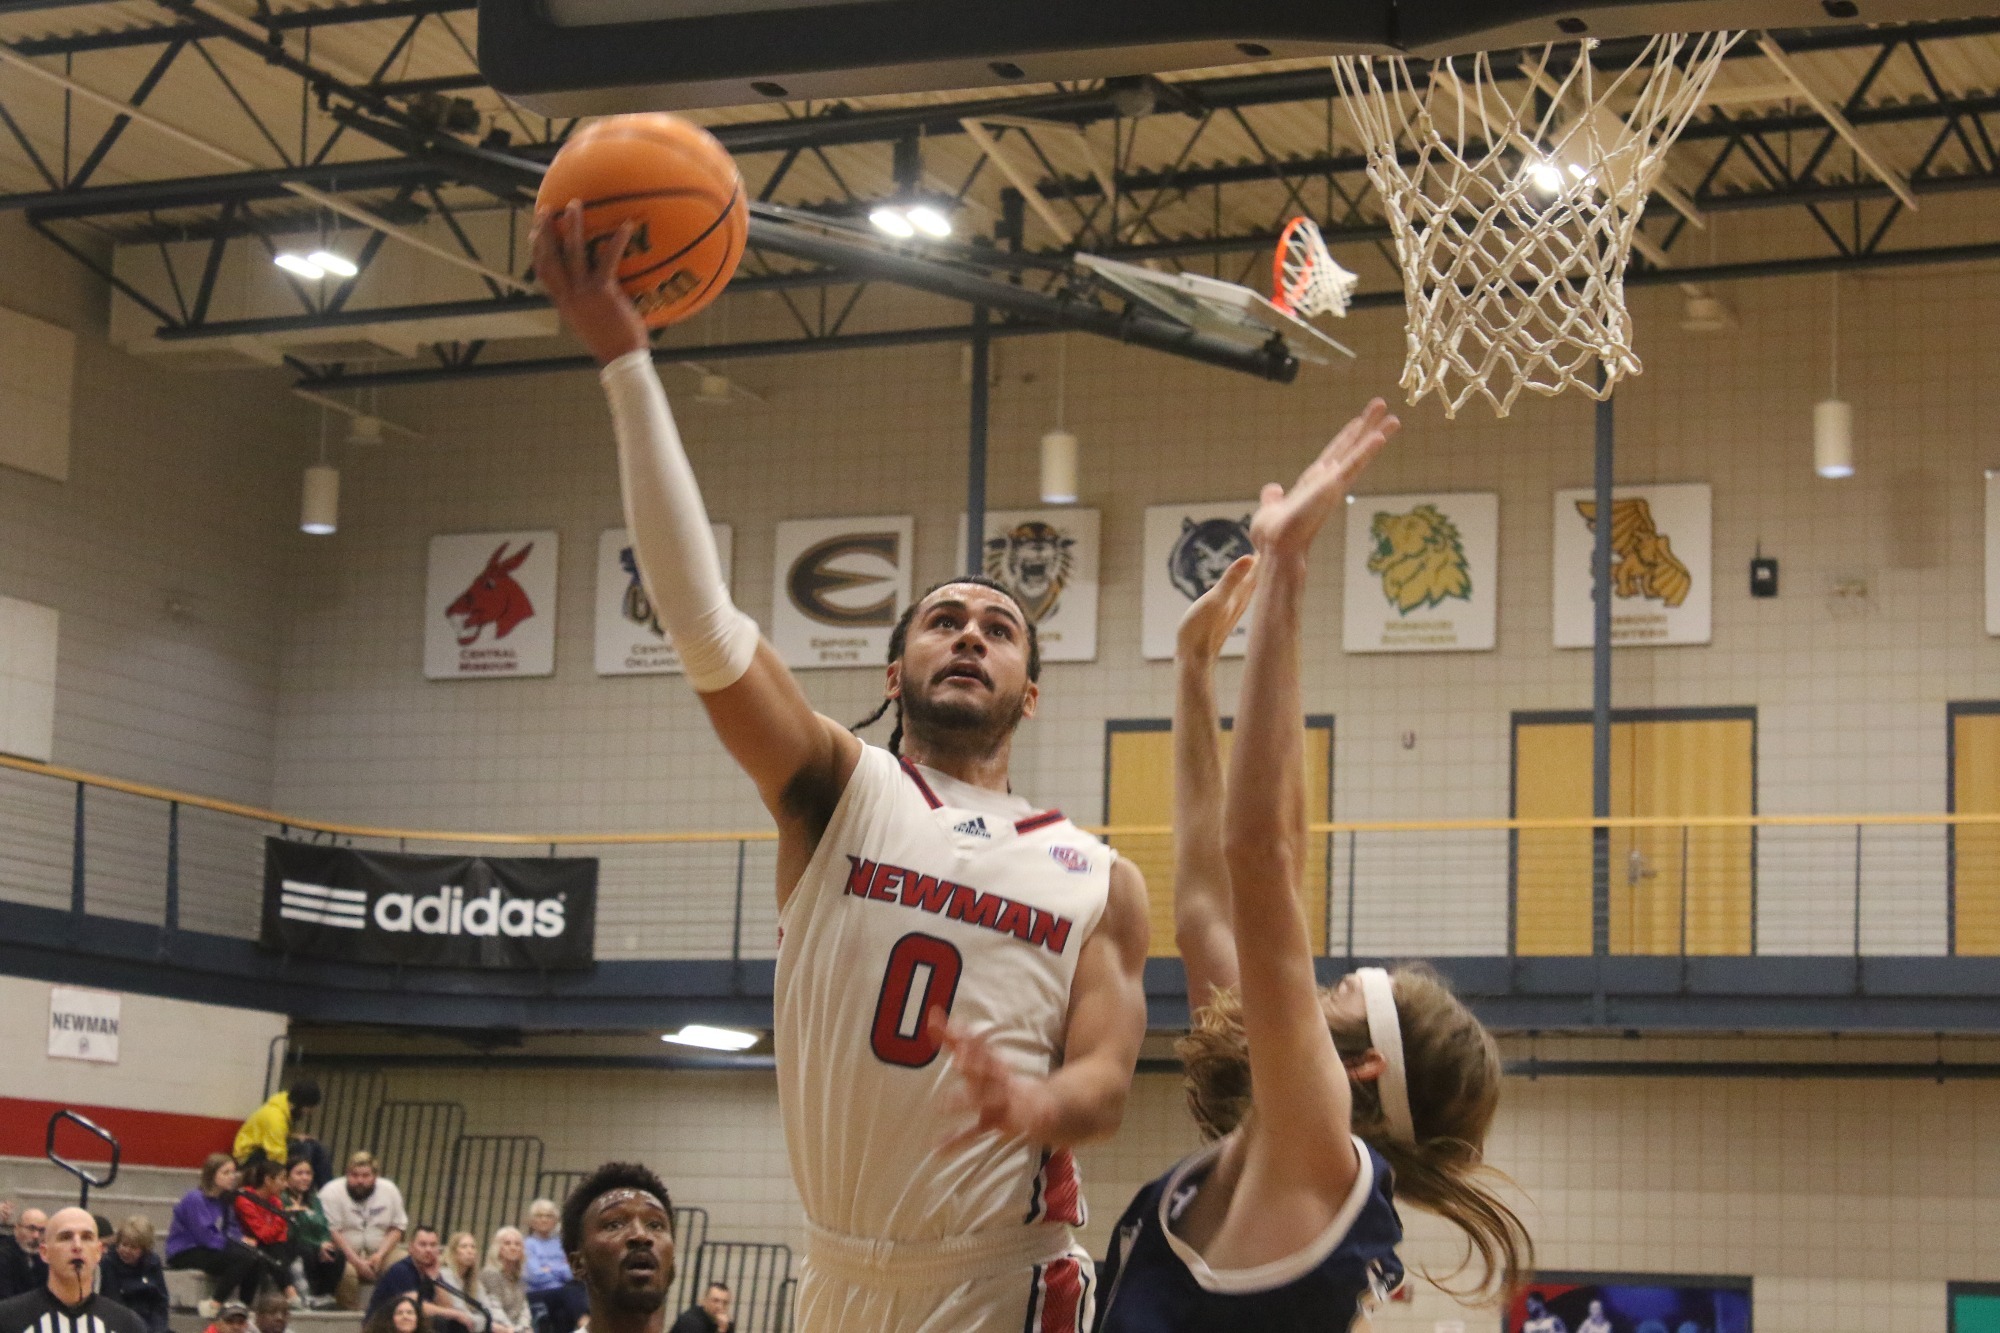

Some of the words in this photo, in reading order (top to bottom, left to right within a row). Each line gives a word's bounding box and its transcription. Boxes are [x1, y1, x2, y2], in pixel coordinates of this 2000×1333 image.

[374, 885, 566, 938] adidas
[844, 854, 1073, 956] NEWMAN
[52, 1011, 119, 1035] NEWMAN
[870, 931, 963, 1069] 0
